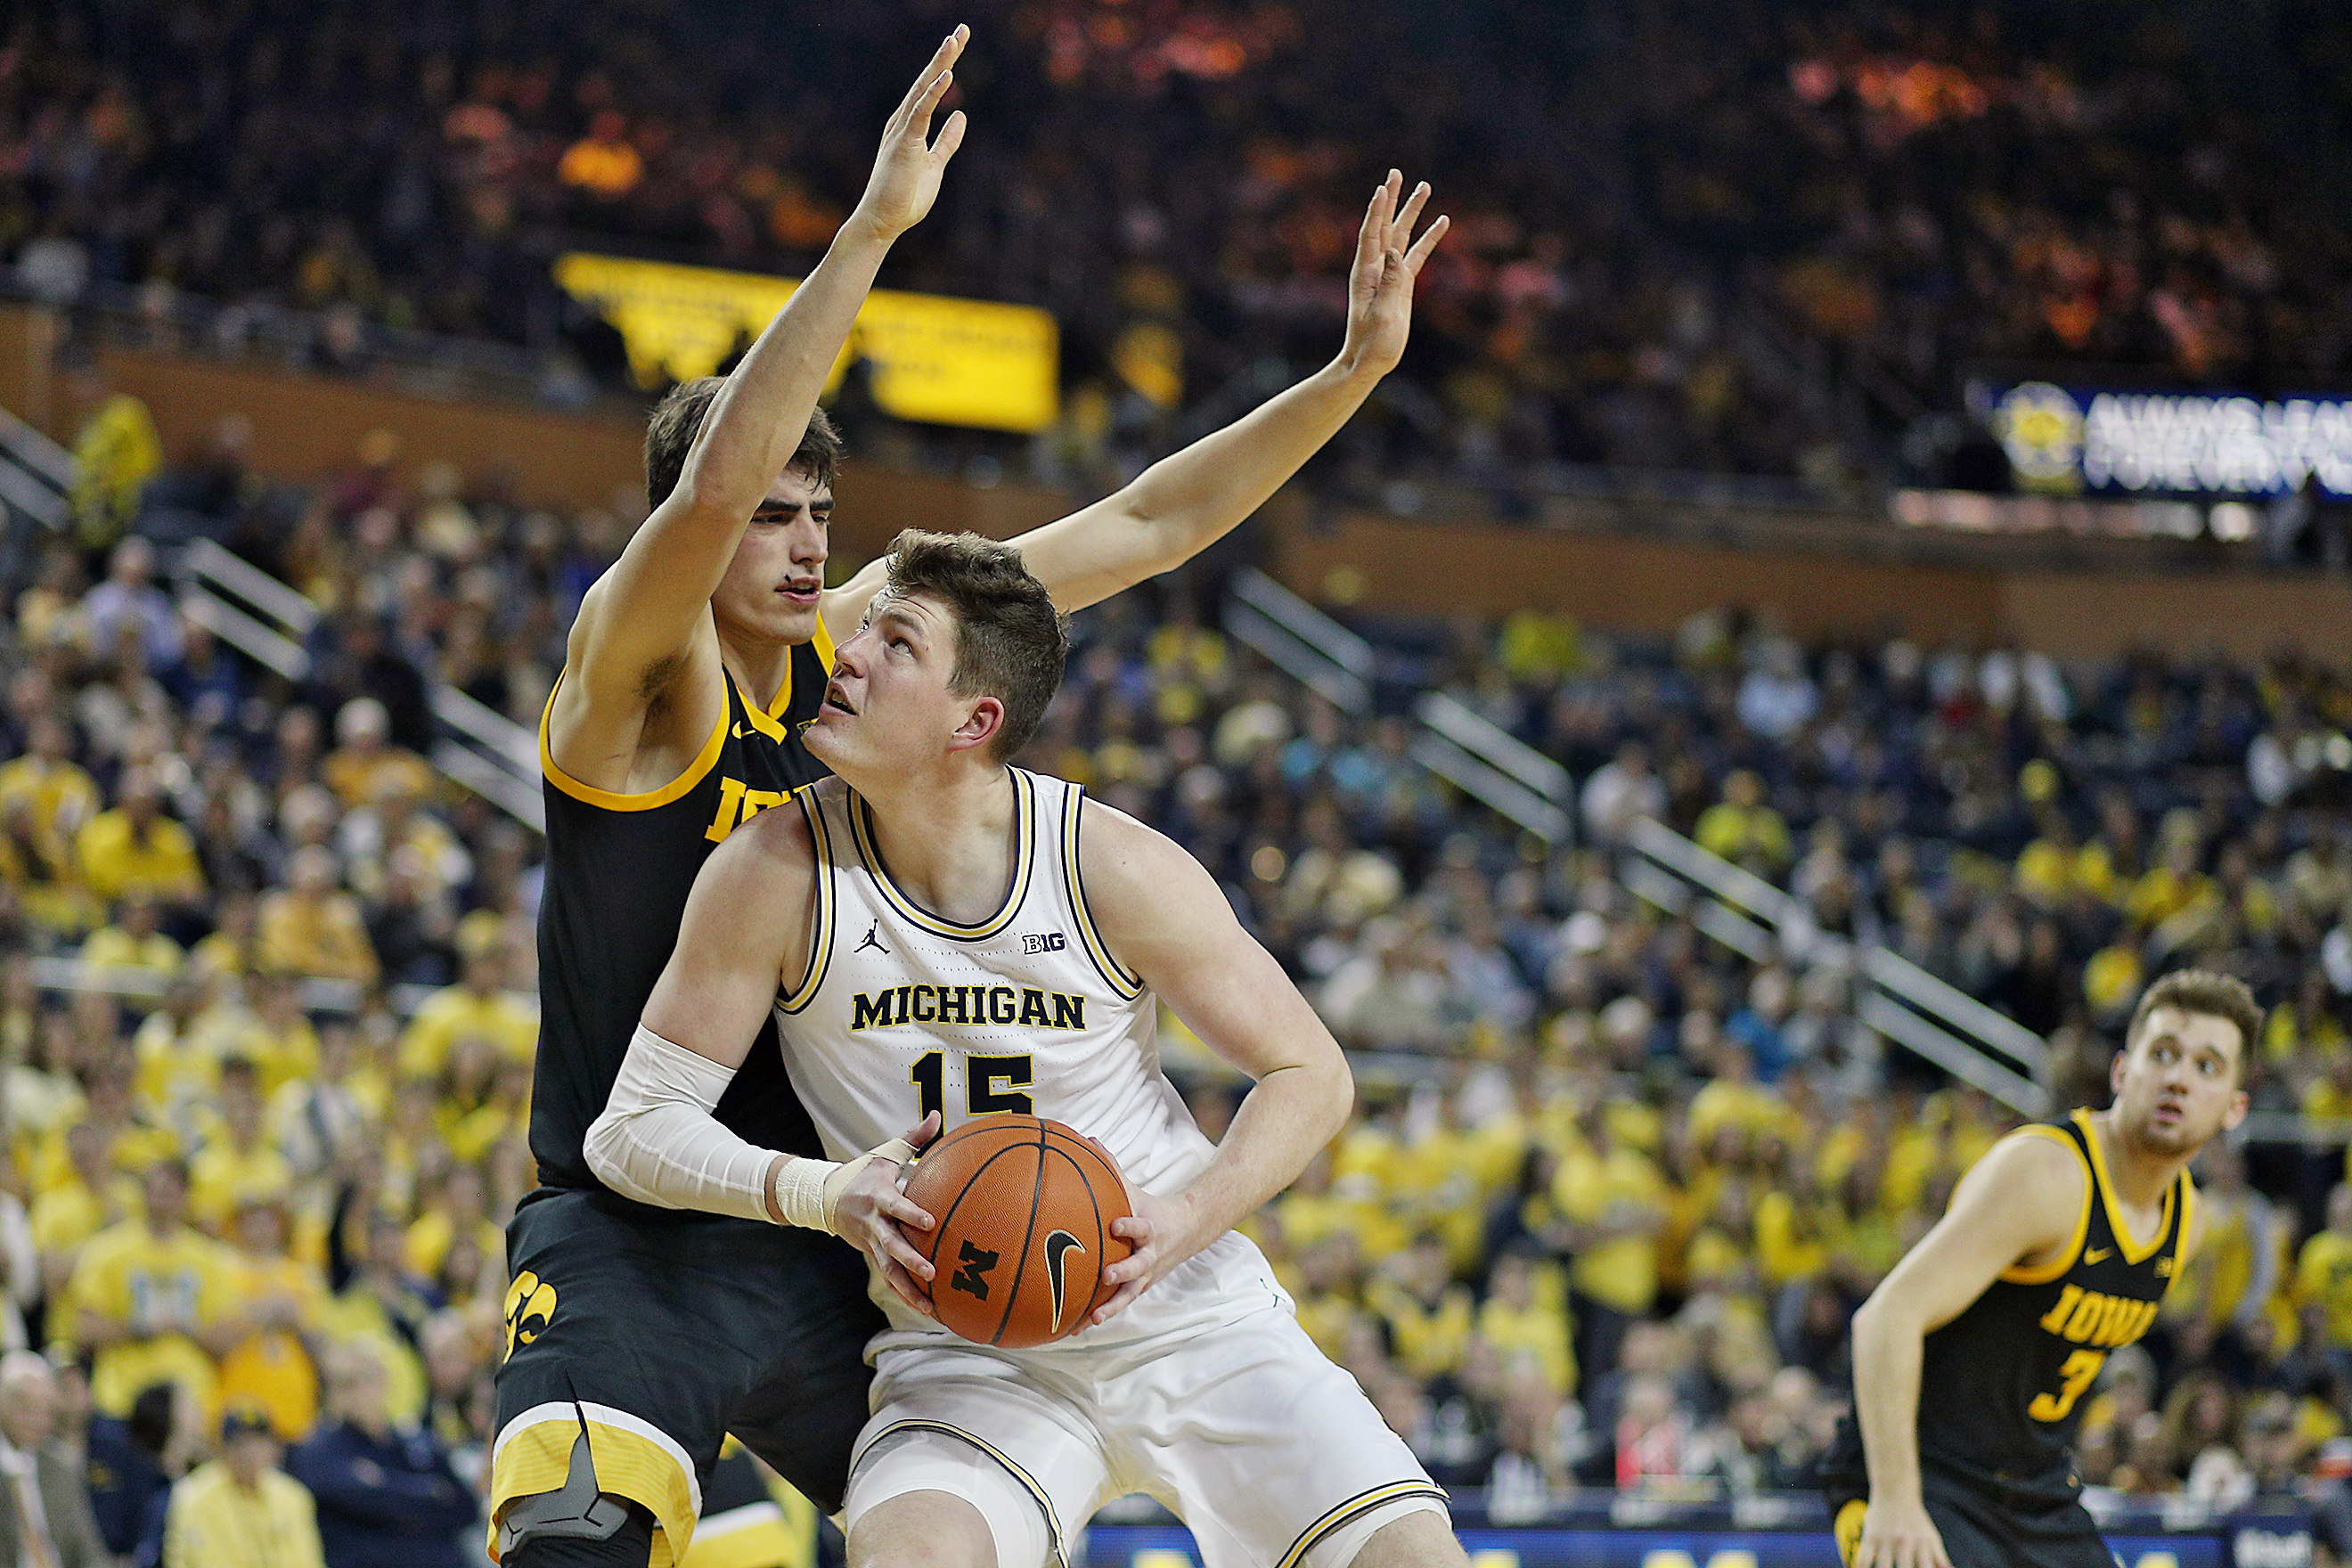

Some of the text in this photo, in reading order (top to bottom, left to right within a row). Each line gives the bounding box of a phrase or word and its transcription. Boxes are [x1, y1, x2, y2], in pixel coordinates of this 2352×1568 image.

[1024, 933, 1066, 954] BIG
[850, 984, 1087, 1031] MICHIGAN
[910, 1050, 1033, 1161] 15
[951, 1239, 1000, 1301] M
